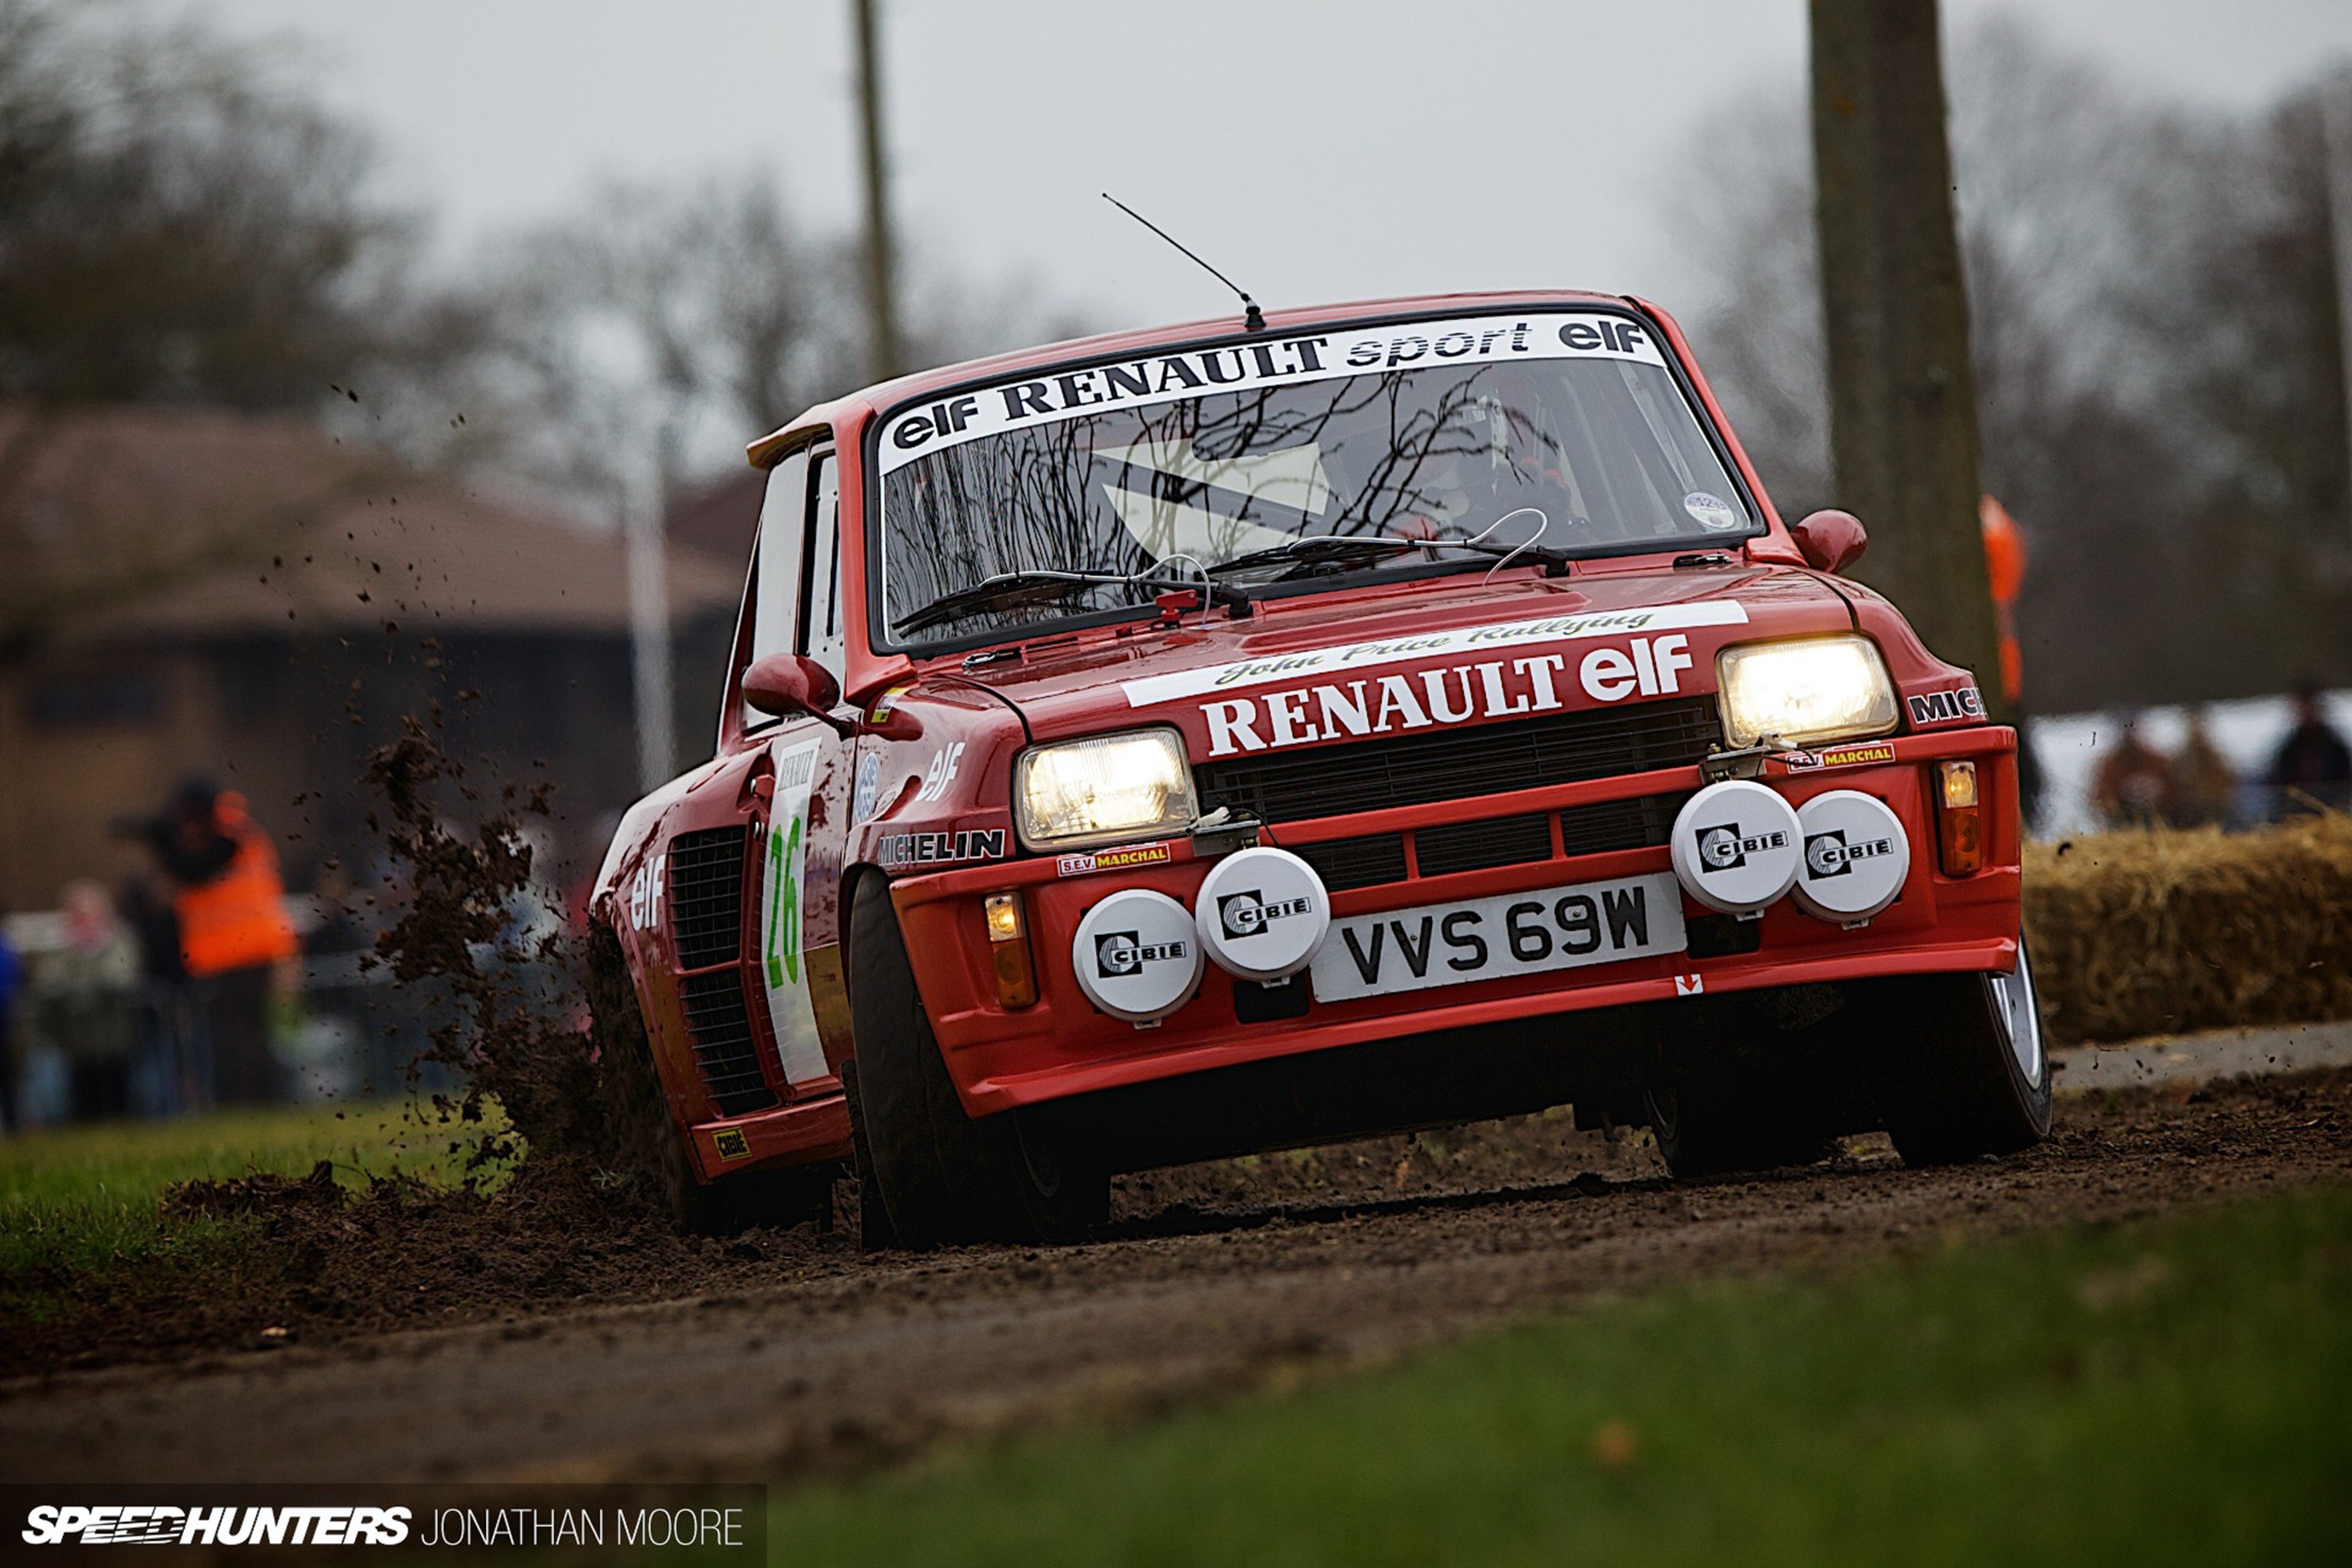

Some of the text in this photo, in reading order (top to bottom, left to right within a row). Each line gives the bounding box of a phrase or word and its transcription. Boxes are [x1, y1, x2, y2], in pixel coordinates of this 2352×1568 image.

[893, 320, 1644, 449] elf RENAULT sport elf
[1215, 613, 1654, 686] John Price Rallying
[1199, 634, 1693, 757] RENAULT elf
[915, 742, 965, 801] elf
[1825, 748, 1891, 765] MARCHAL
[878, 829, 1005, 866] MICHELIN
[1097, 849, 1166, 867] MARCHAL
[631, 854, 665, 931] elf
[1342, 886, 1649, 985] VVS 69W
